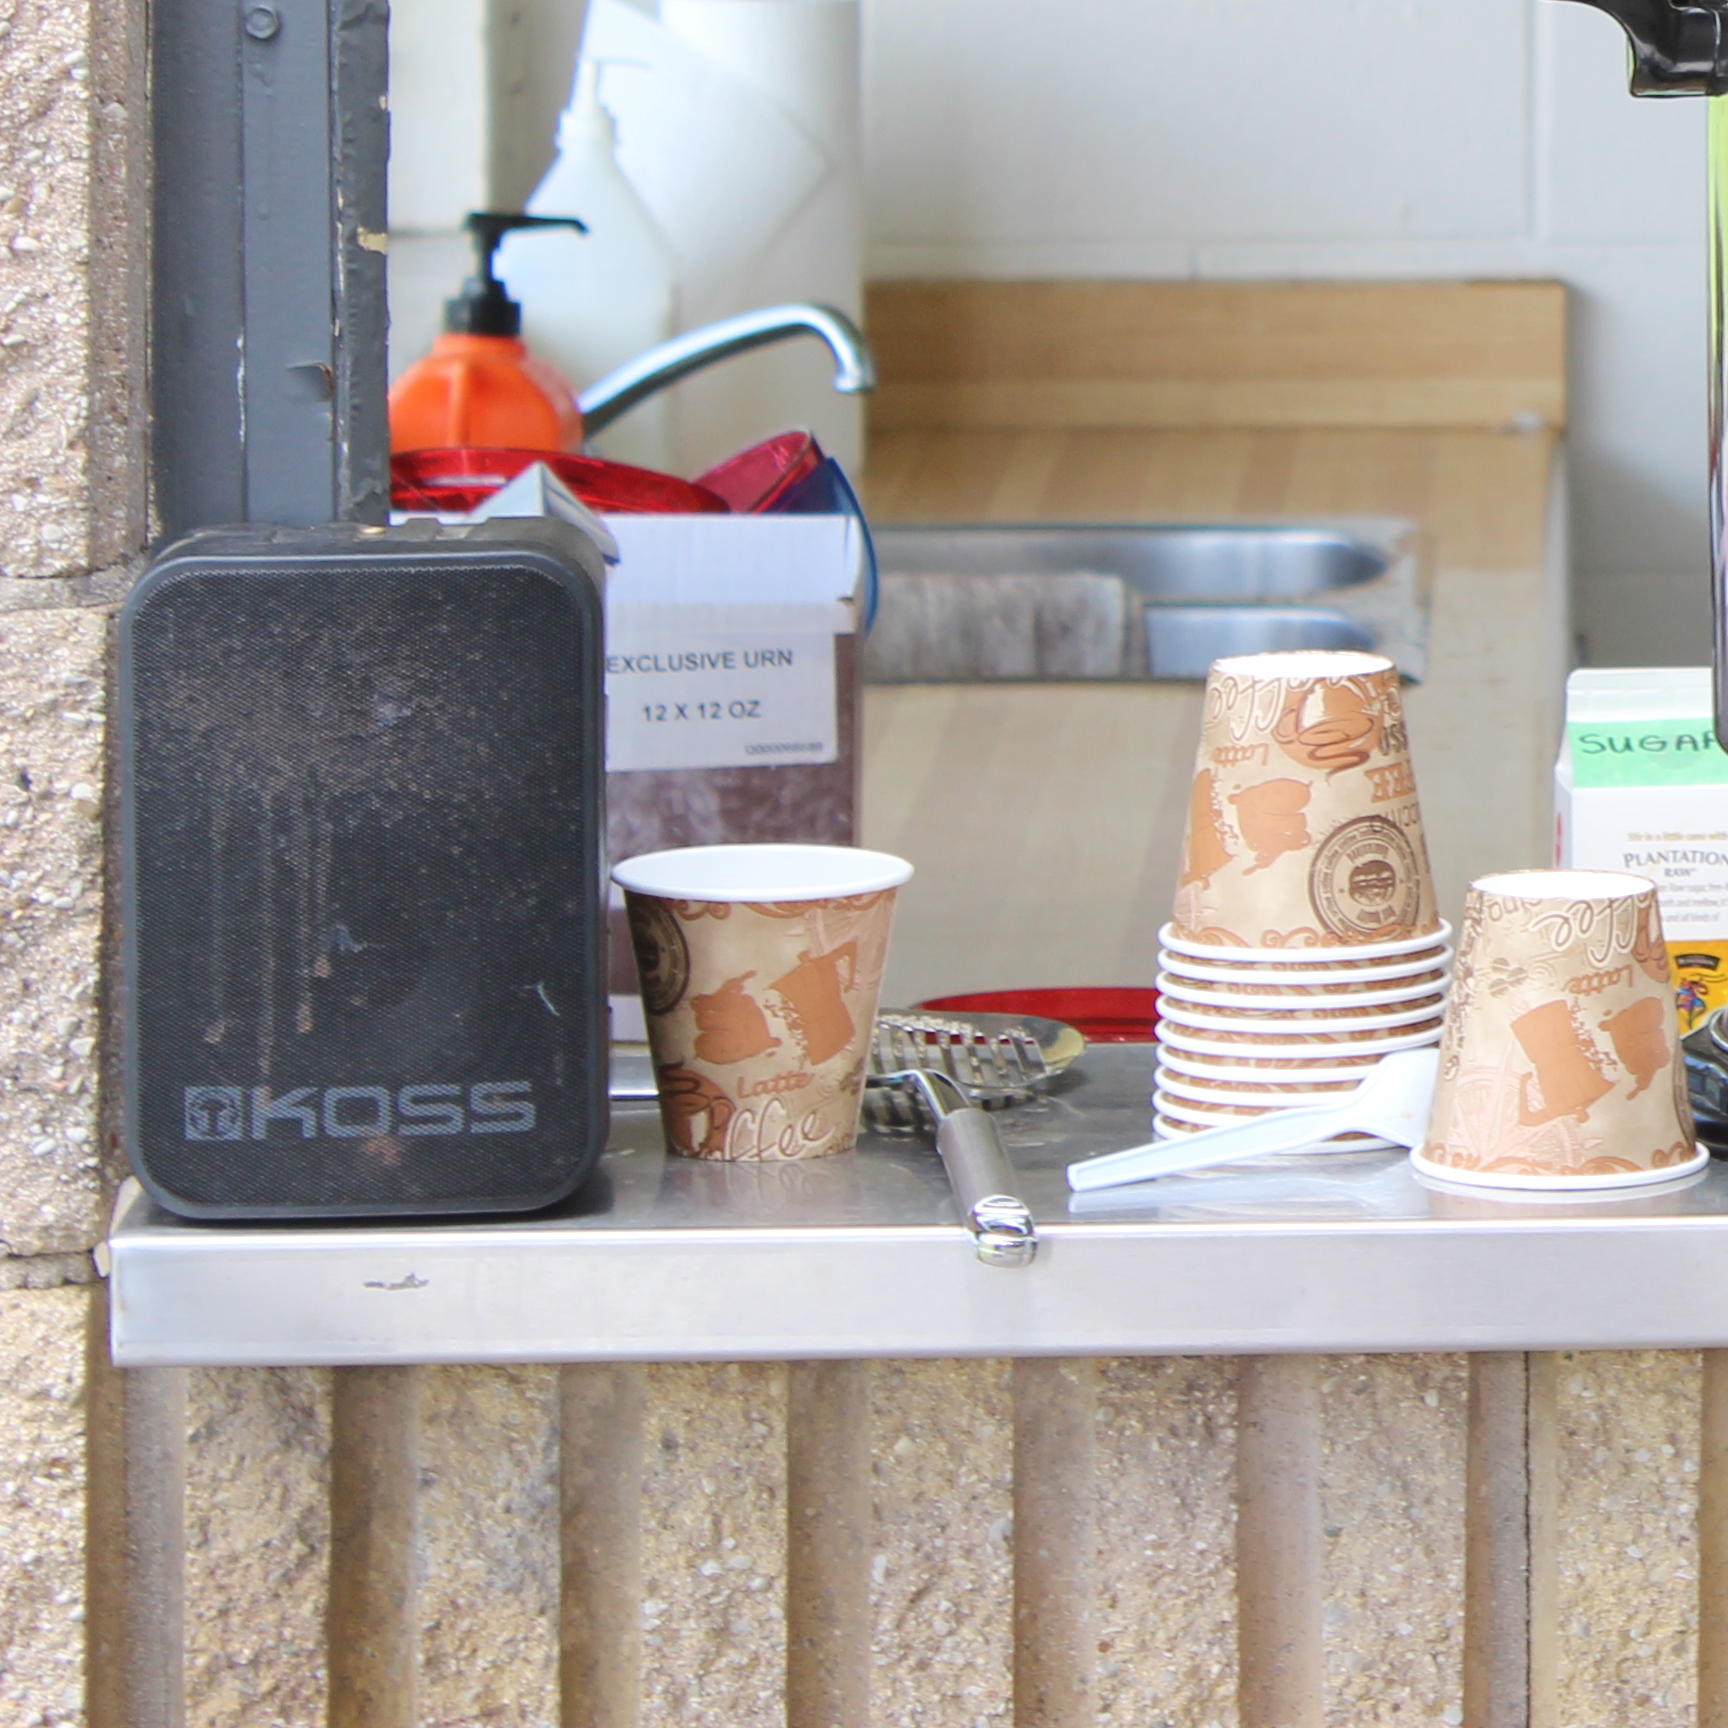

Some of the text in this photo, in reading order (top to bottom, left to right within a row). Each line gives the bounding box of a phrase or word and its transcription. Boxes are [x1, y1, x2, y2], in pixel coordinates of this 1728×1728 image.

[606, 649, 794, 674] EXCLUSIVE URN
[643, 700, 762, 722] 12 X 12 OZ
[250, 1080, 537, 1141] KOSS
